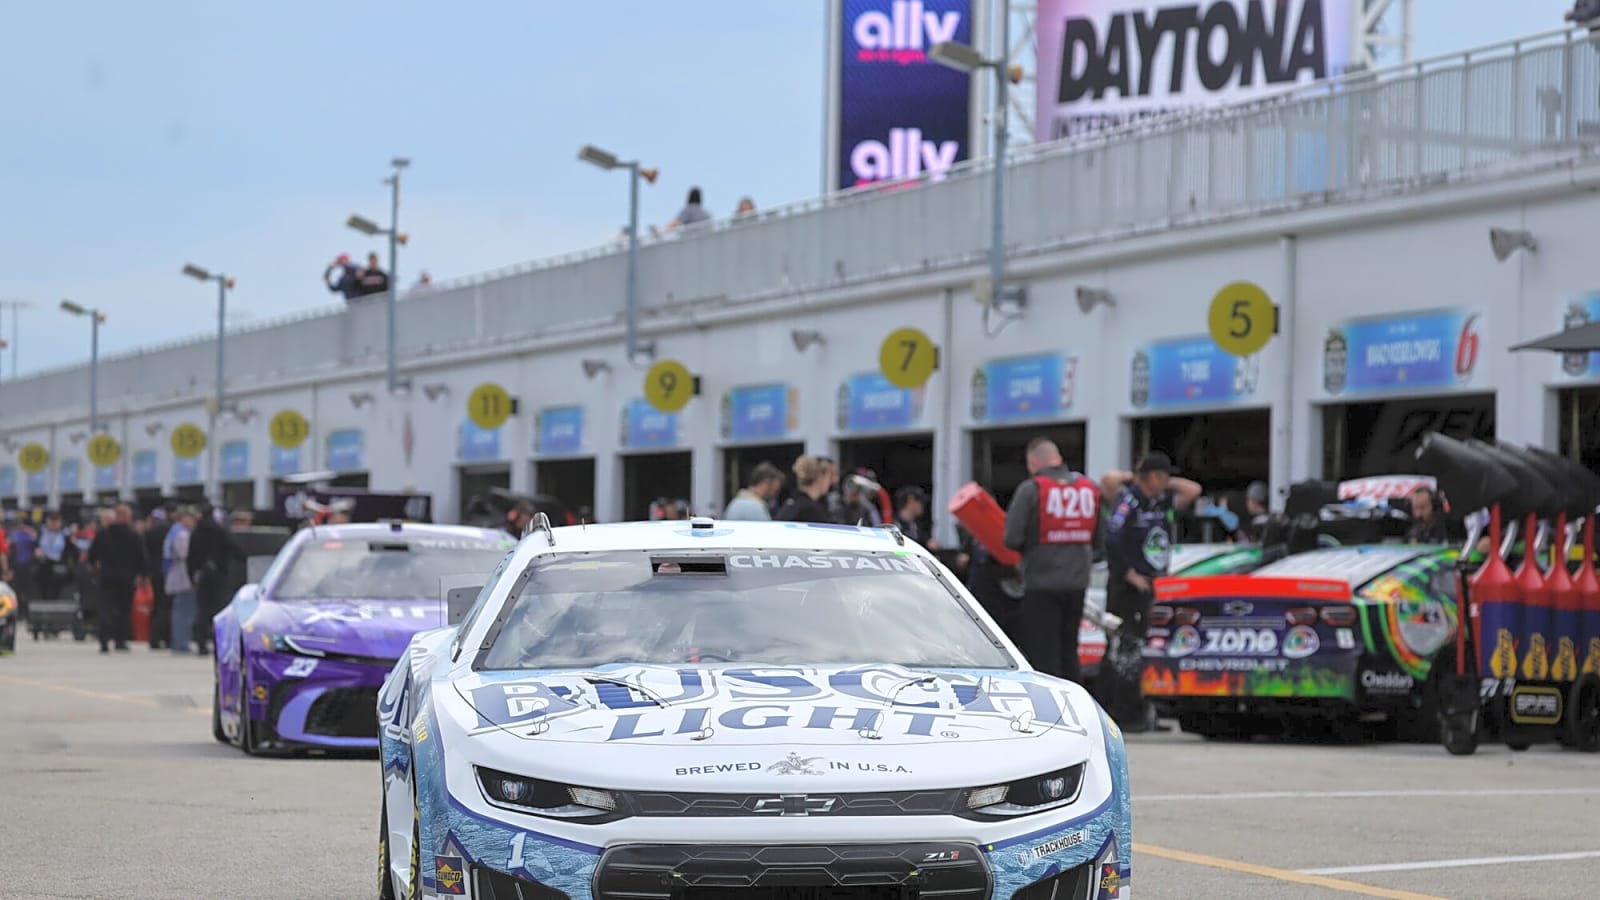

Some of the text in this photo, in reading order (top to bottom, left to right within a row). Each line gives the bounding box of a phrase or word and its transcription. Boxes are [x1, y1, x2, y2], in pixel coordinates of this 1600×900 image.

[853, 0, 961, 49] ally
[1058, 0, 1327, 103] DAYTONA
[850, 128, 960, 182] ally
[1229, 300, 1253, 340] 5
[898, 340, 918, 374] 7
[1456, 312, 1480, 377] 6
[658, 371, 677, 399] 9
[481, 393, 500, 417] 11
[278, 418, 299, 436] 13
[1046, 486, 1096, 519] 420
[729, 554, 915, 572] CHASTAIN
[1204, 628, 1278, 653] zone
[1179, 658, 1290, 671] CHEVROLET
[468, 666, 1088, 737] BUSCH
[604, 704, 957, 742] LIGHT
[675, 761, 914, 776] BREWED IN U.S.A.
[507, 832, 527, 870] 1
[1034, 831, 1083, 858] TRACKHOUSE
[436, 870, 462, 882] SUNOCO
